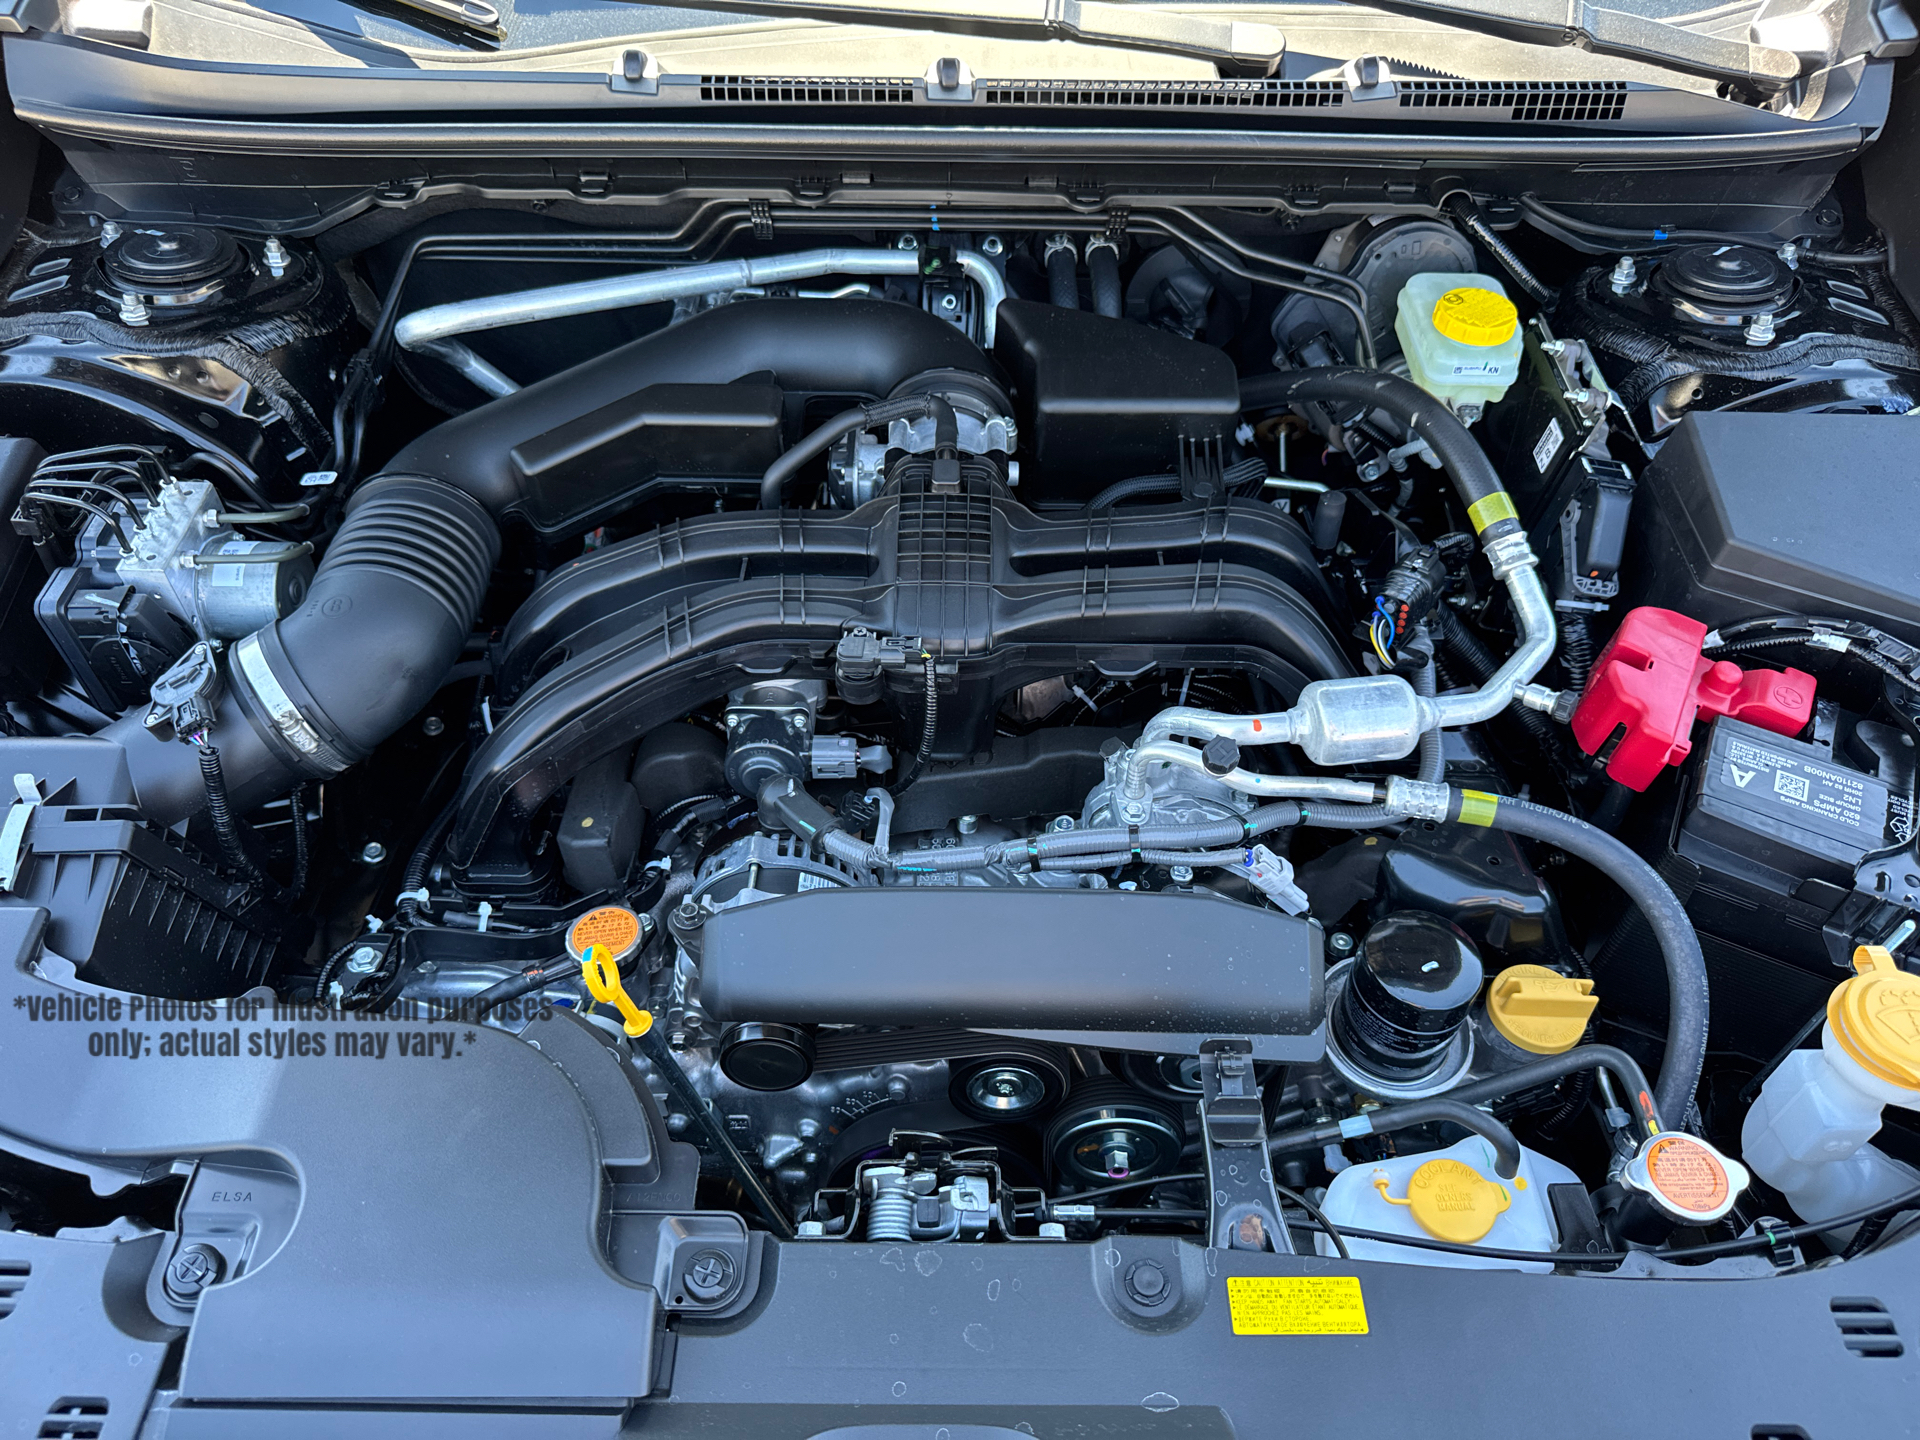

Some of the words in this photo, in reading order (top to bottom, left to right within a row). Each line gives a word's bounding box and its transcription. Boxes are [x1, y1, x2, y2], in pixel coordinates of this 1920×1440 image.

[1487, 366, 1499, 374] KN
[1730, 764, 1756, 788] A
[1803, 764, 1864, 789] 82110AN00B
[1779, 795, 1800, 805] AMPS
[1817, 793, 1834, 802] SIZE
[1842, 793, 1862, 805] LN2
[1800, 802, 1838, 819] CRANKING
[1812, 799, 1841, 814] AMPS
[1834, 799, 1861, 811] GROUP
[1838, 815, 1859, 826] COLD
[1842, 809, 1860, 820] 620
[1414, 1162, 1485, 1189] COOLANT
[212, 1192, 253, 1202] ELSA
